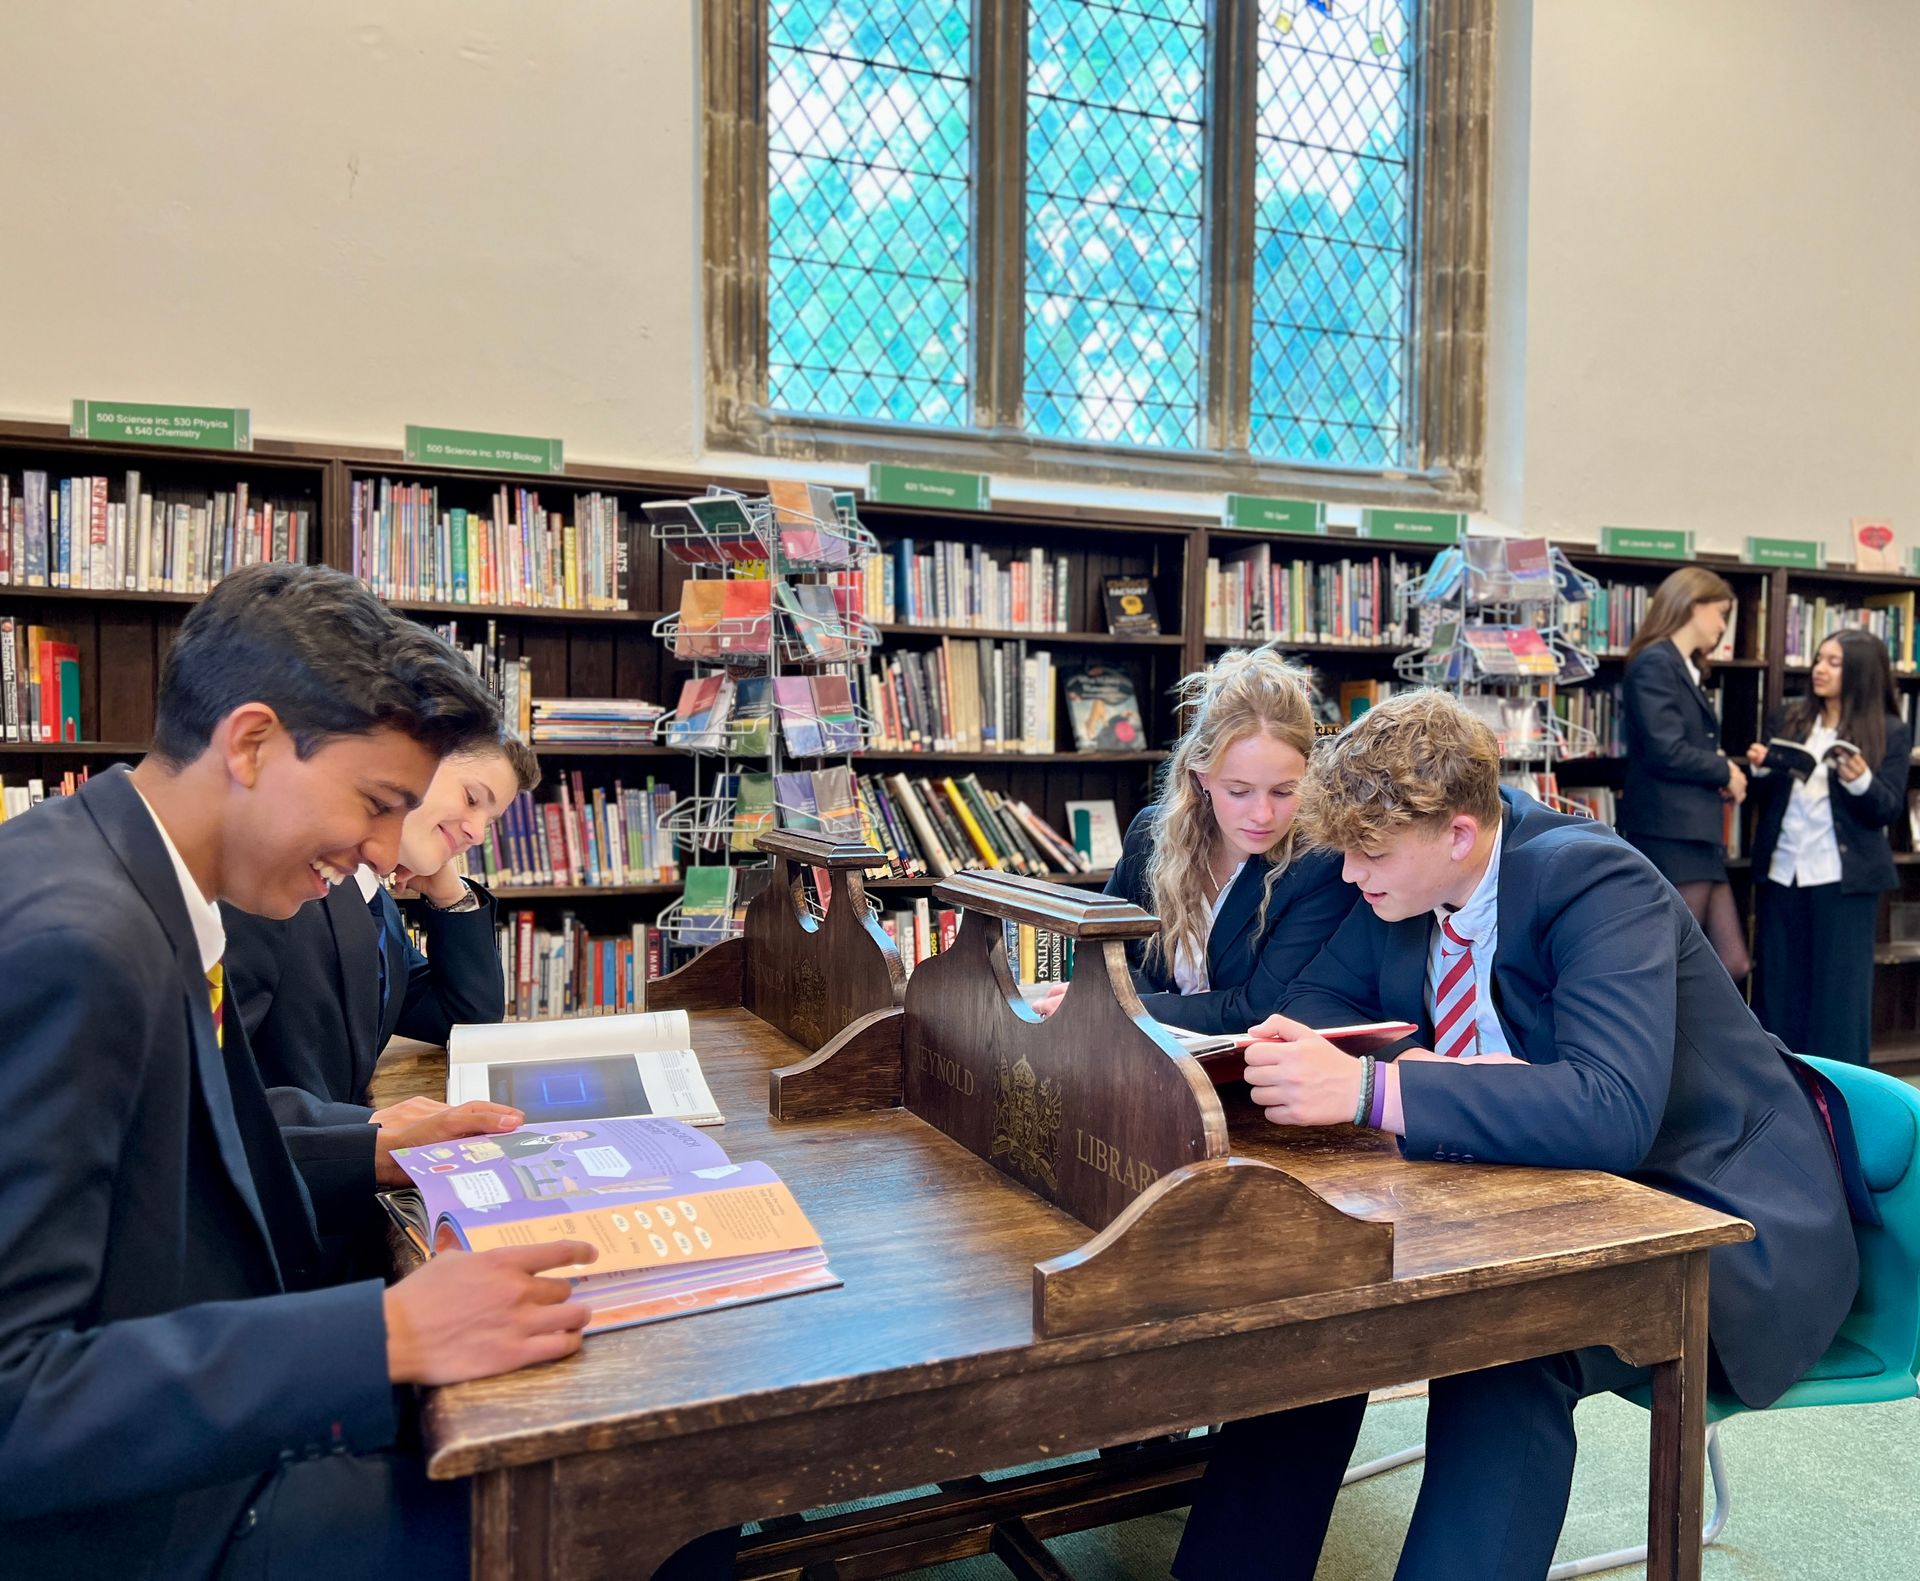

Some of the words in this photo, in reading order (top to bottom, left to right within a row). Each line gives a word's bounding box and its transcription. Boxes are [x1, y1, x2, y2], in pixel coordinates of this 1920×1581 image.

[96, 412, 114, 423] 500
[116, 414, 152, 425] Science
[155, 416, 170, 427] inc.
[173, 417, 191, 427] 530
[193, 418, 228, 430] Physics
[124, 426, 133, 435] &
[135, 426, 152, 436] 540
[154, 427, 201, 440] Chemistry
[426, 443, 443, 454] 500
[444, 445, 478, 457] Science
[496, 449, 512, 460] 570
[513, 452, 543, 463] Biology
[918, 483, 956, 496] Technology
[617, 542, 628, 573] BATS
[2, 637, 14, 681] Elements
